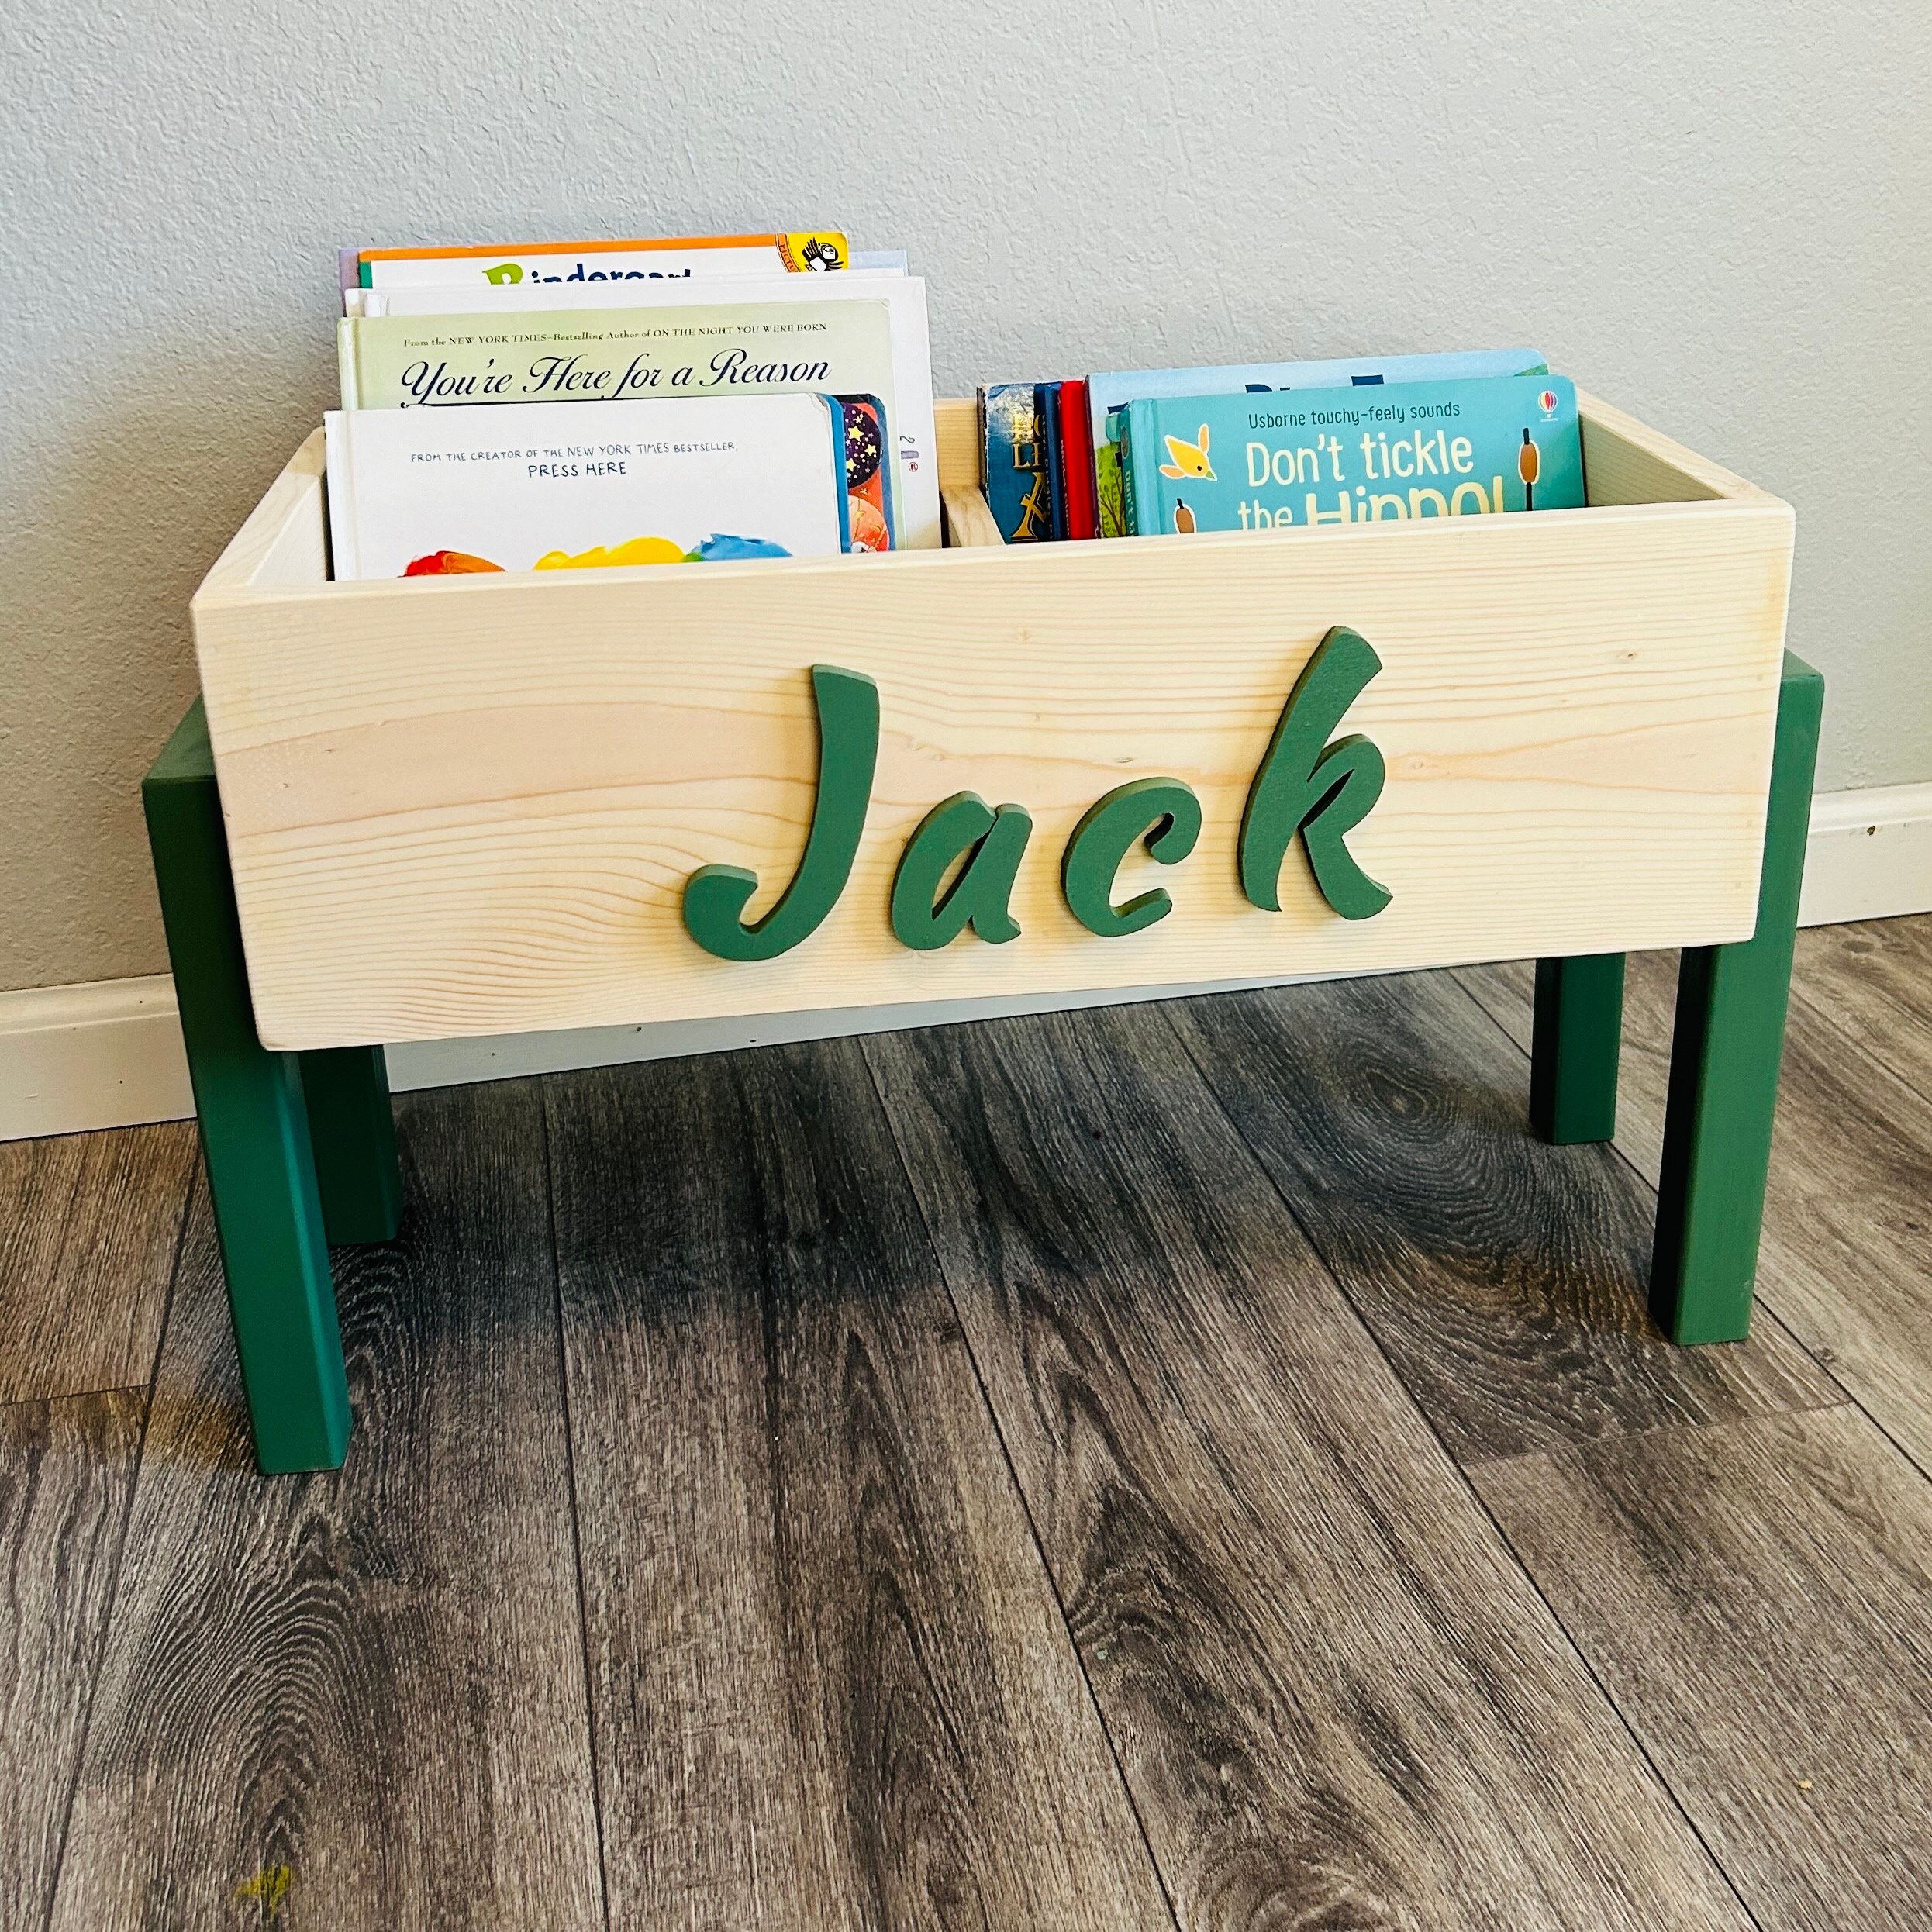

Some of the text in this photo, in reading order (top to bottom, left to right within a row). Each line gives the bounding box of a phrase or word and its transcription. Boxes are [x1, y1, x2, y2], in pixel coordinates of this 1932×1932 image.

[404, 338, 429, 347] From
[431, 337, 447, 346] the
[449, 336, 474, 345] NEW
[478, 335, 509, 343] YORK
[606, 329, 640, 340] Author
[641, 329, 651, 338] of
[653, 329, 670, 337] ON
[672, 328, 695, 336] THE
[698, 326, 734, 336] NIGHT
[737, 326, 759, 334] YOU
[763, 324, 794, 333] WERE
[797, 323, 828, 332] BORN
[400, 348, 833, 409] You're Here for a Reason
[1248, 402, 1461, 429] Usborne touchy-feely sounds
[411, 454, 442, 463] FROM
[446, 453, 466, 462] THE
[471, 450, 522, 461] CREATOR
[526, 449, 540, 457] OF
[543, 448, 564, 457] THE
[567, 446, 595, 457] NEW
[599, 443, 632, 456] YORK
[637, 442, 670, 454] TIMES
[1246, 429, 1474, 487] Don't tickle
[528, 461, 628, 478] PRESS HERE
[1237, 499, 1293, 530] the
[683, 626, 1394, 962] Jack
